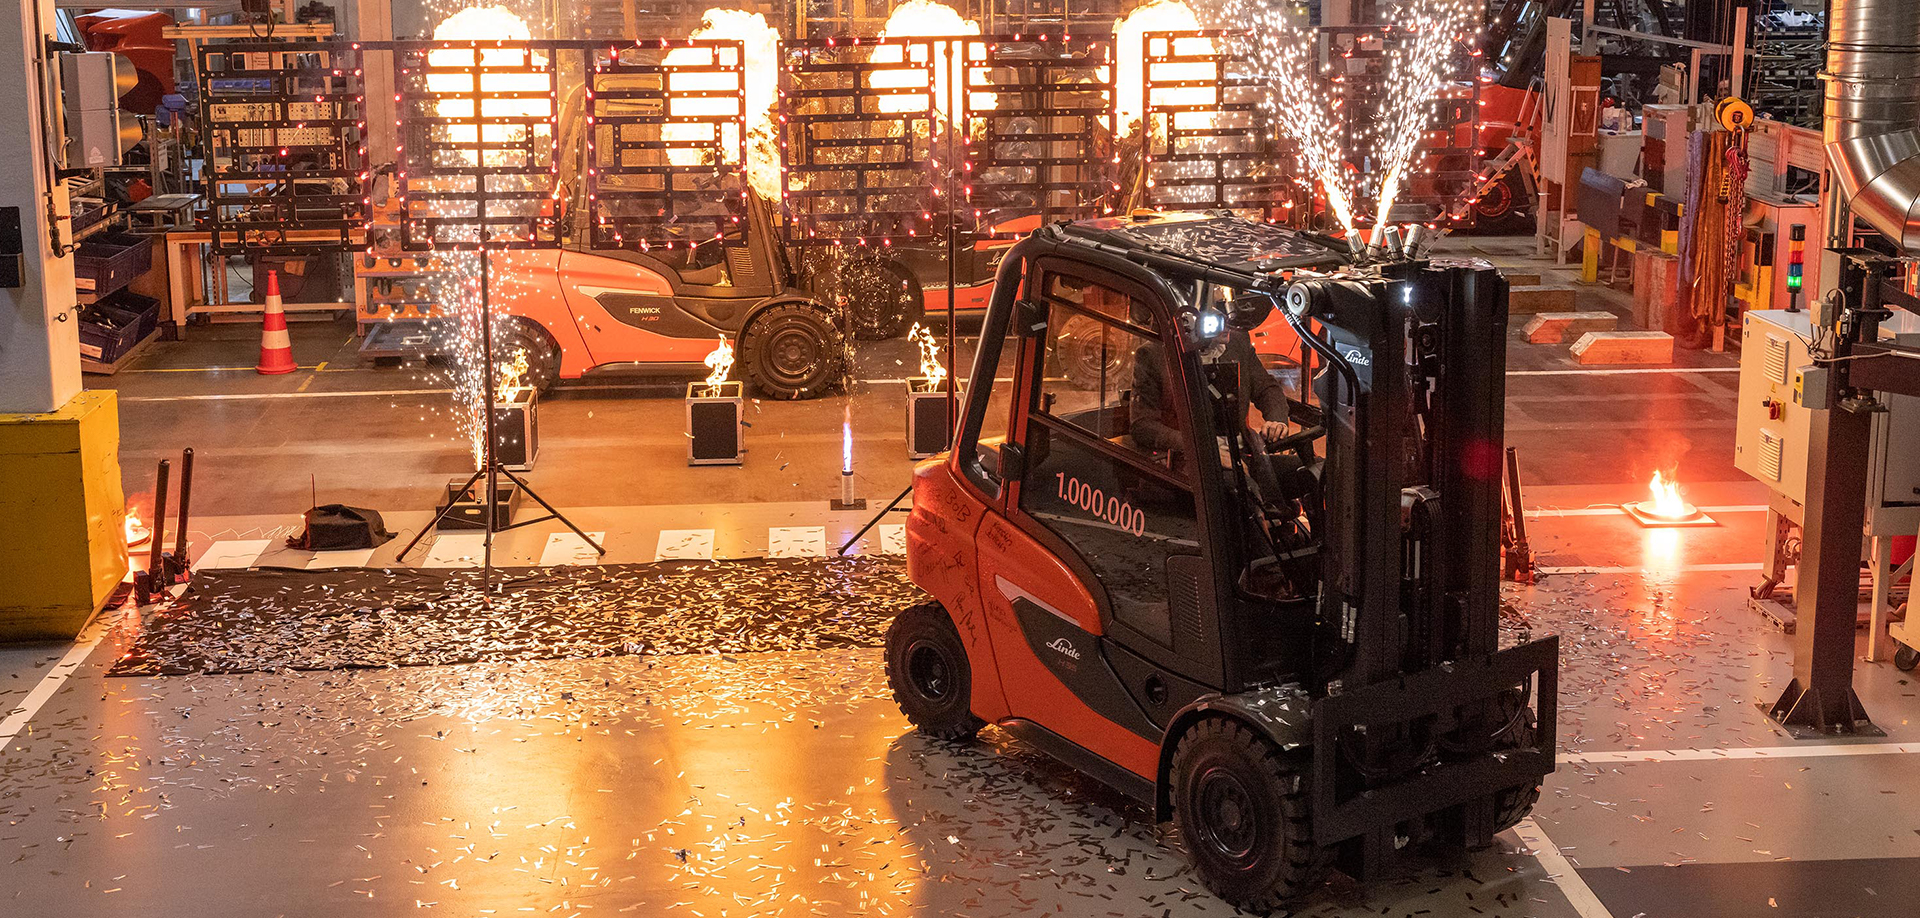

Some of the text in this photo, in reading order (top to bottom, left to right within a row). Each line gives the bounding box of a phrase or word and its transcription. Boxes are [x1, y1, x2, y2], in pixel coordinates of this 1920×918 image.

[1344, 349, 1370, 366] Linde
[1056, 472, 1145, 537] 1.000.000
[1045, 637, 1081, 660] Linde
